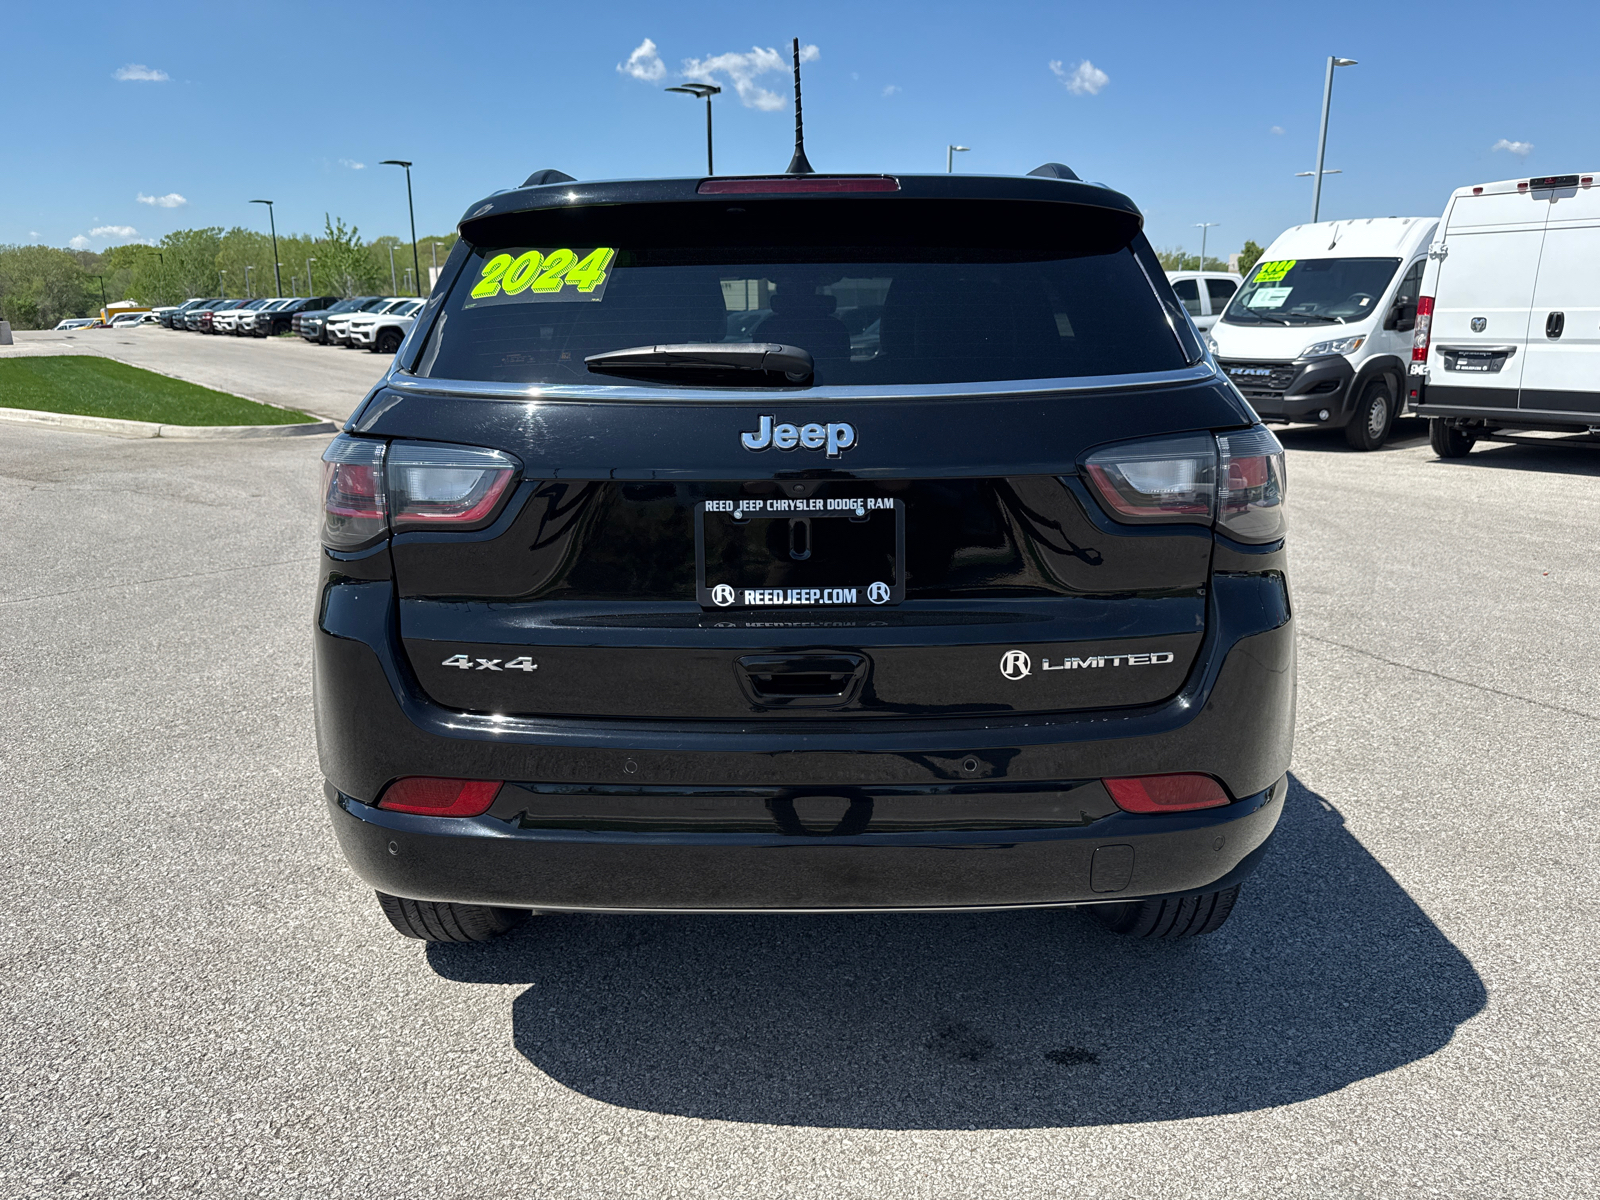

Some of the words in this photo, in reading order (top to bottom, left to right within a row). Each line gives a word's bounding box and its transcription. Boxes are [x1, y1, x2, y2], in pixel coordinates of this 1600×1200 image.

[470, 247, 615, 299] 2024
[1230, 367, 1271, 376] RAM
[741, 414, 857, 458] Jeep
[705, 500, 734, 512] REED
[738, 500, 763, 512] JEEP
[766, 499, 824, 511] CHRYSLER
[826, 498, 864, 510] DODGE
[867, 497, 894, 509] RAM
[744, 588, 857, 605] REEDJEEP.COM
[441, 653, 538, 672] 4x4
[1000, 649, 1032, 681] R
[1042, 651, 1174, 671] LIMITED
